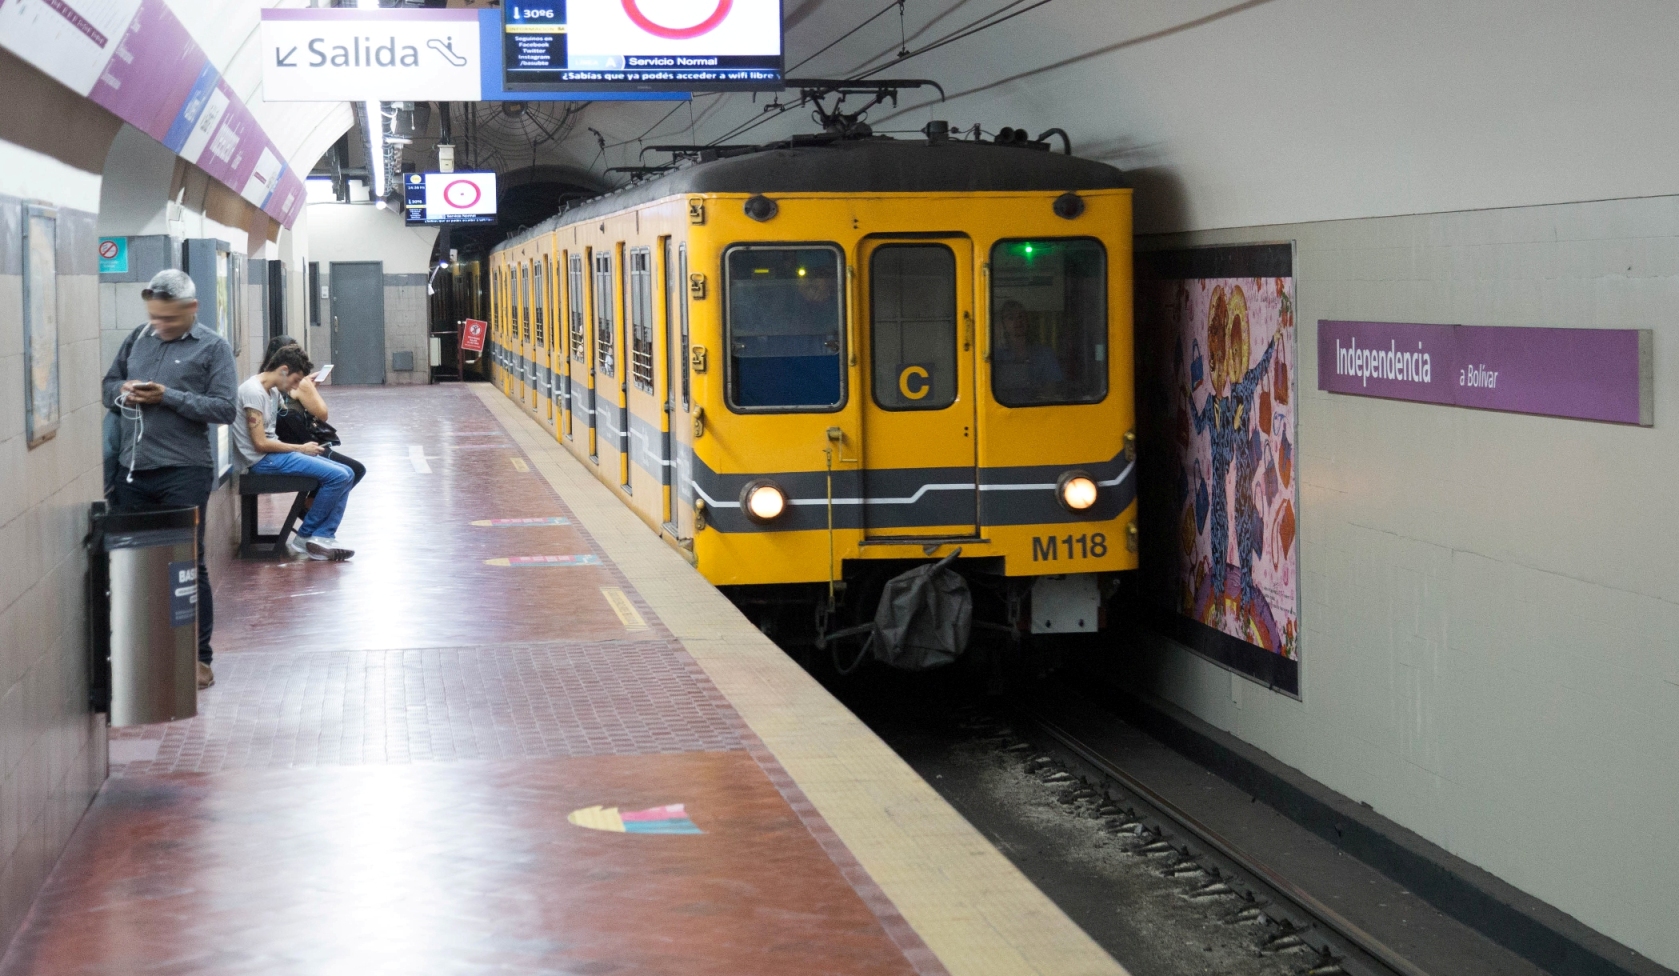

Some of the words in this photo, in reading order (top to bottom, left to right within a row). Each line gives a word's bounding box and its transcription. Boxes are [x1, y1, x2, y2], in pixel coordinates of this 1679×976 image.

[307, 36, 420, 68] Salida
[605, 57, 617, 68] A
[628, 57, 675, 66] Servicio
[676, 57, 718, 66] Normal
[562, 72, 602, 80] ¿Sabías
[604, 73, 625, 81] que
[642, 72, 674, 81] podés
[676, 72, 717, 80] acceder
[1336, 337, 1431, 387] Independencia
[1459, 368, 1465, 386] a
[1467, 363, 1498, 388] Bolívar
[899, 365, 930, 400] C
[1032, 532, 1107, 562] M118
